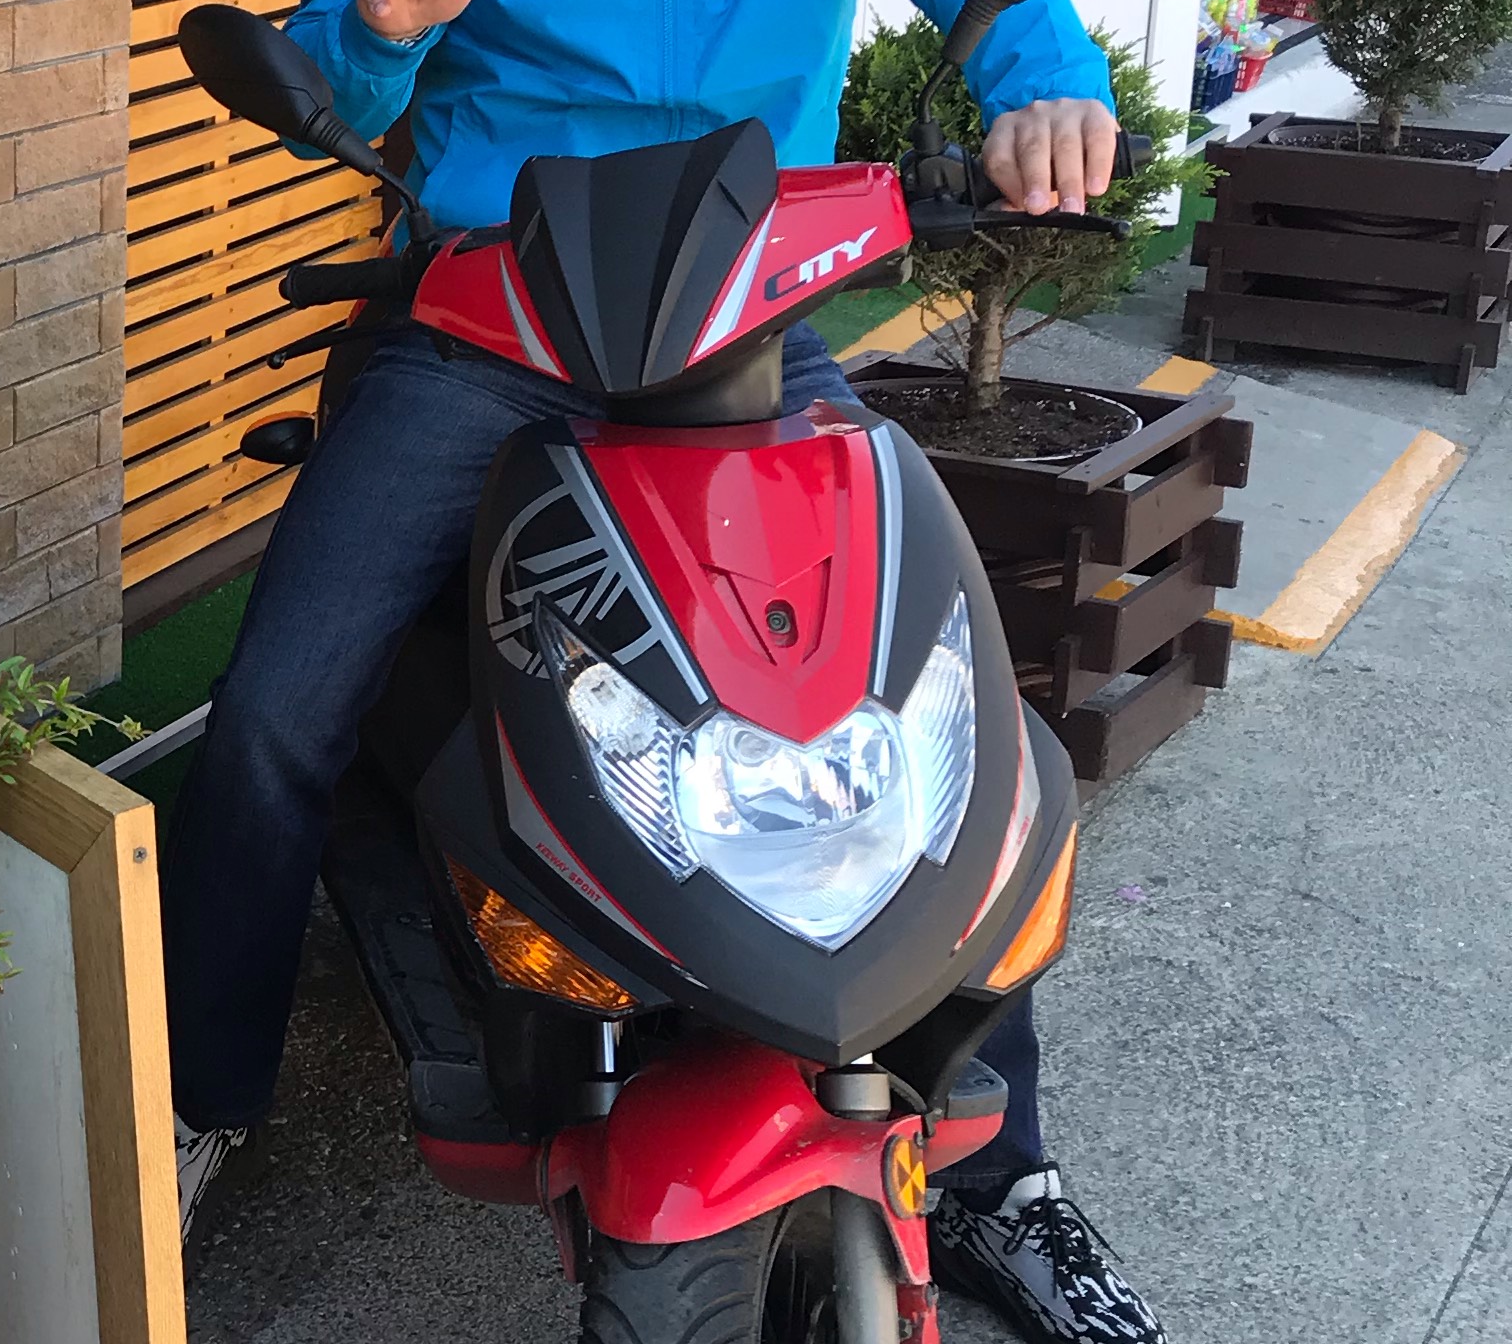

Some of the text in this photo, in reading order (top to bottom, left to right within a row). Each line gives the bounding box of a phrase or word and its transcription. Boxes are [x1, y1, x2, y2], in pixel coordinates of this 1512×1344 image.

[764, 225, 878, 302] CITY
[535, 841, 602, 903] KEEWAY SPORT
